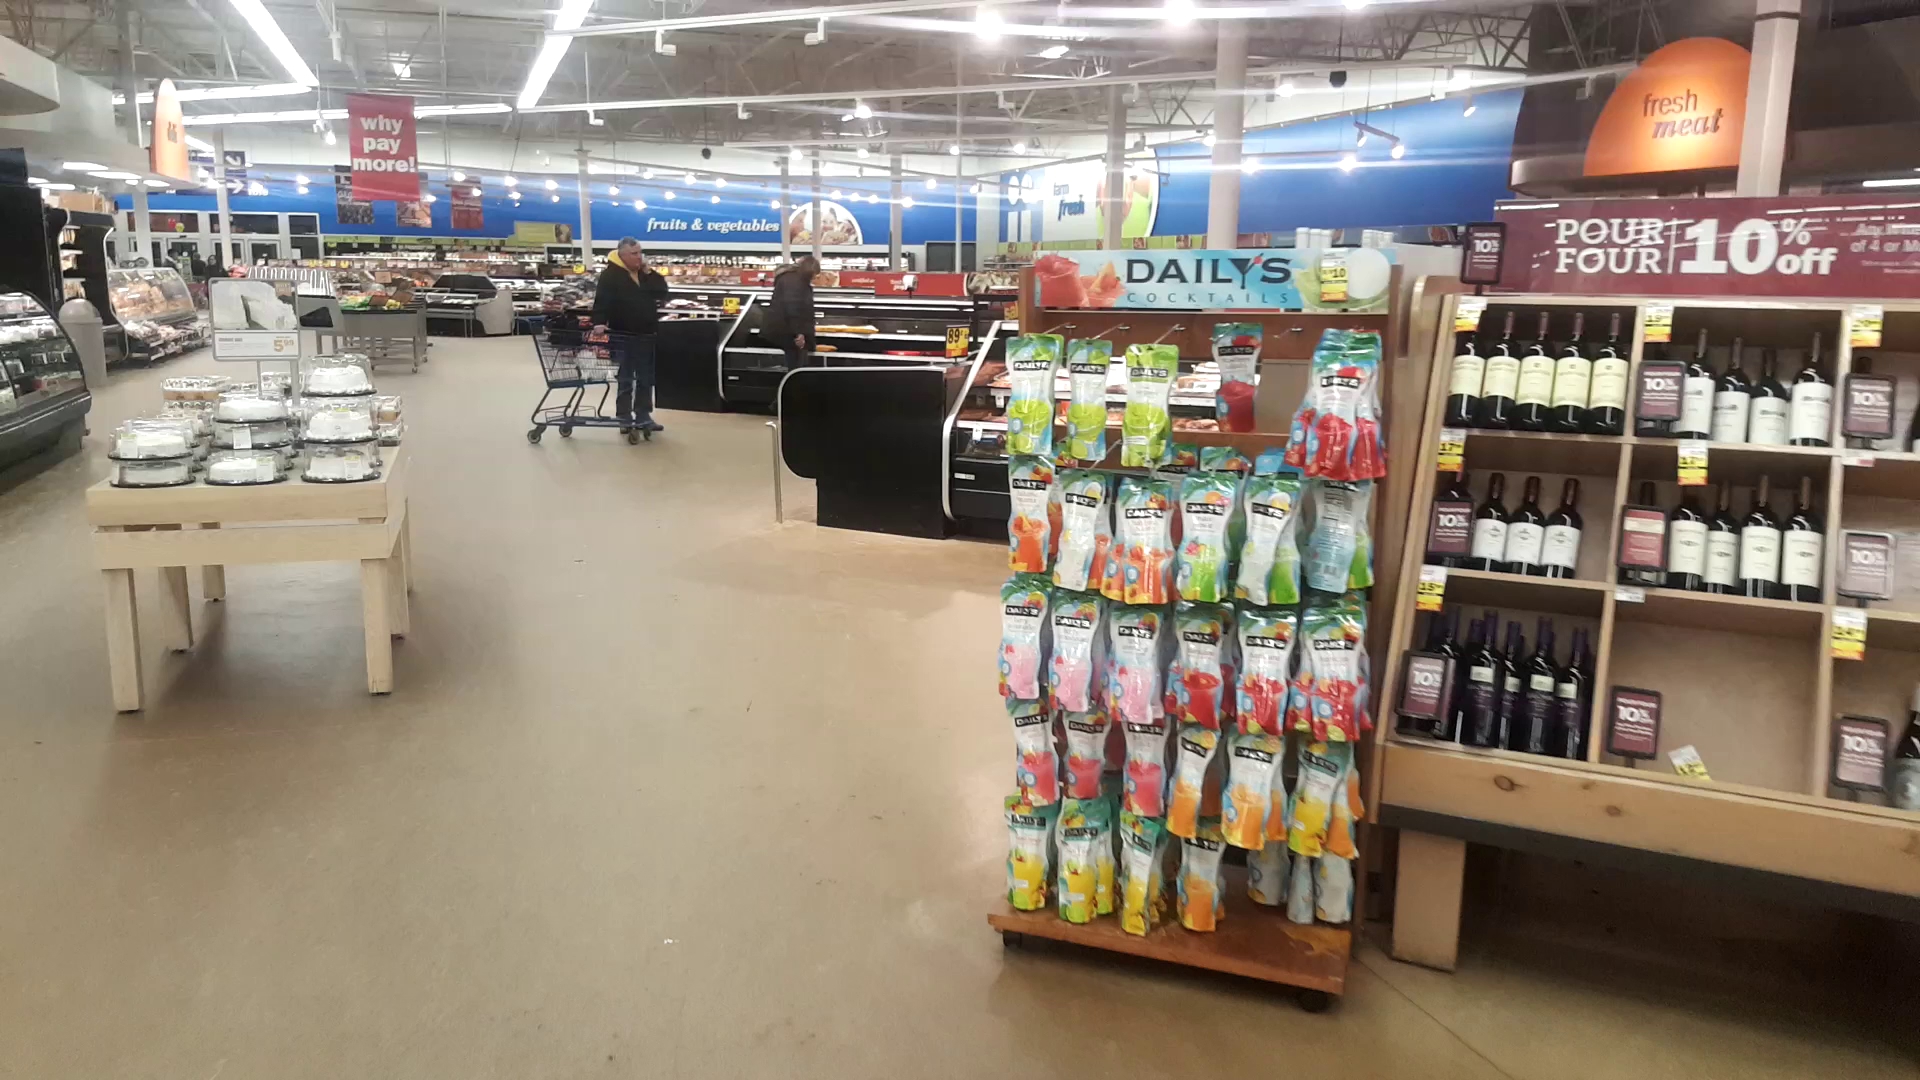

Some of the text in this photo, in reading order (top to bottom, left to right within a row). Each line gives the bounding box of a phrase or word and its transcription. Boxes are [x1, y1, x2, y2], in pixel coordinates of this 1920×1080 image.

[1643, 89, 1698, 117] fresh
[360, 115, 403, 135] why
[1652, 107, 1724, 139] meat
[363, 136, 401, 155] pay
[352, 156, 416, 173] more!
[647, 217, 780, 234] fruits & vegetables
[1555, 217, 1665, 245] POUR
[1555, 248, 1663, 275] FOUR
[1775, 247, 1839, 275] off
[1127, 292, 1289, 304] COCKTAILS
